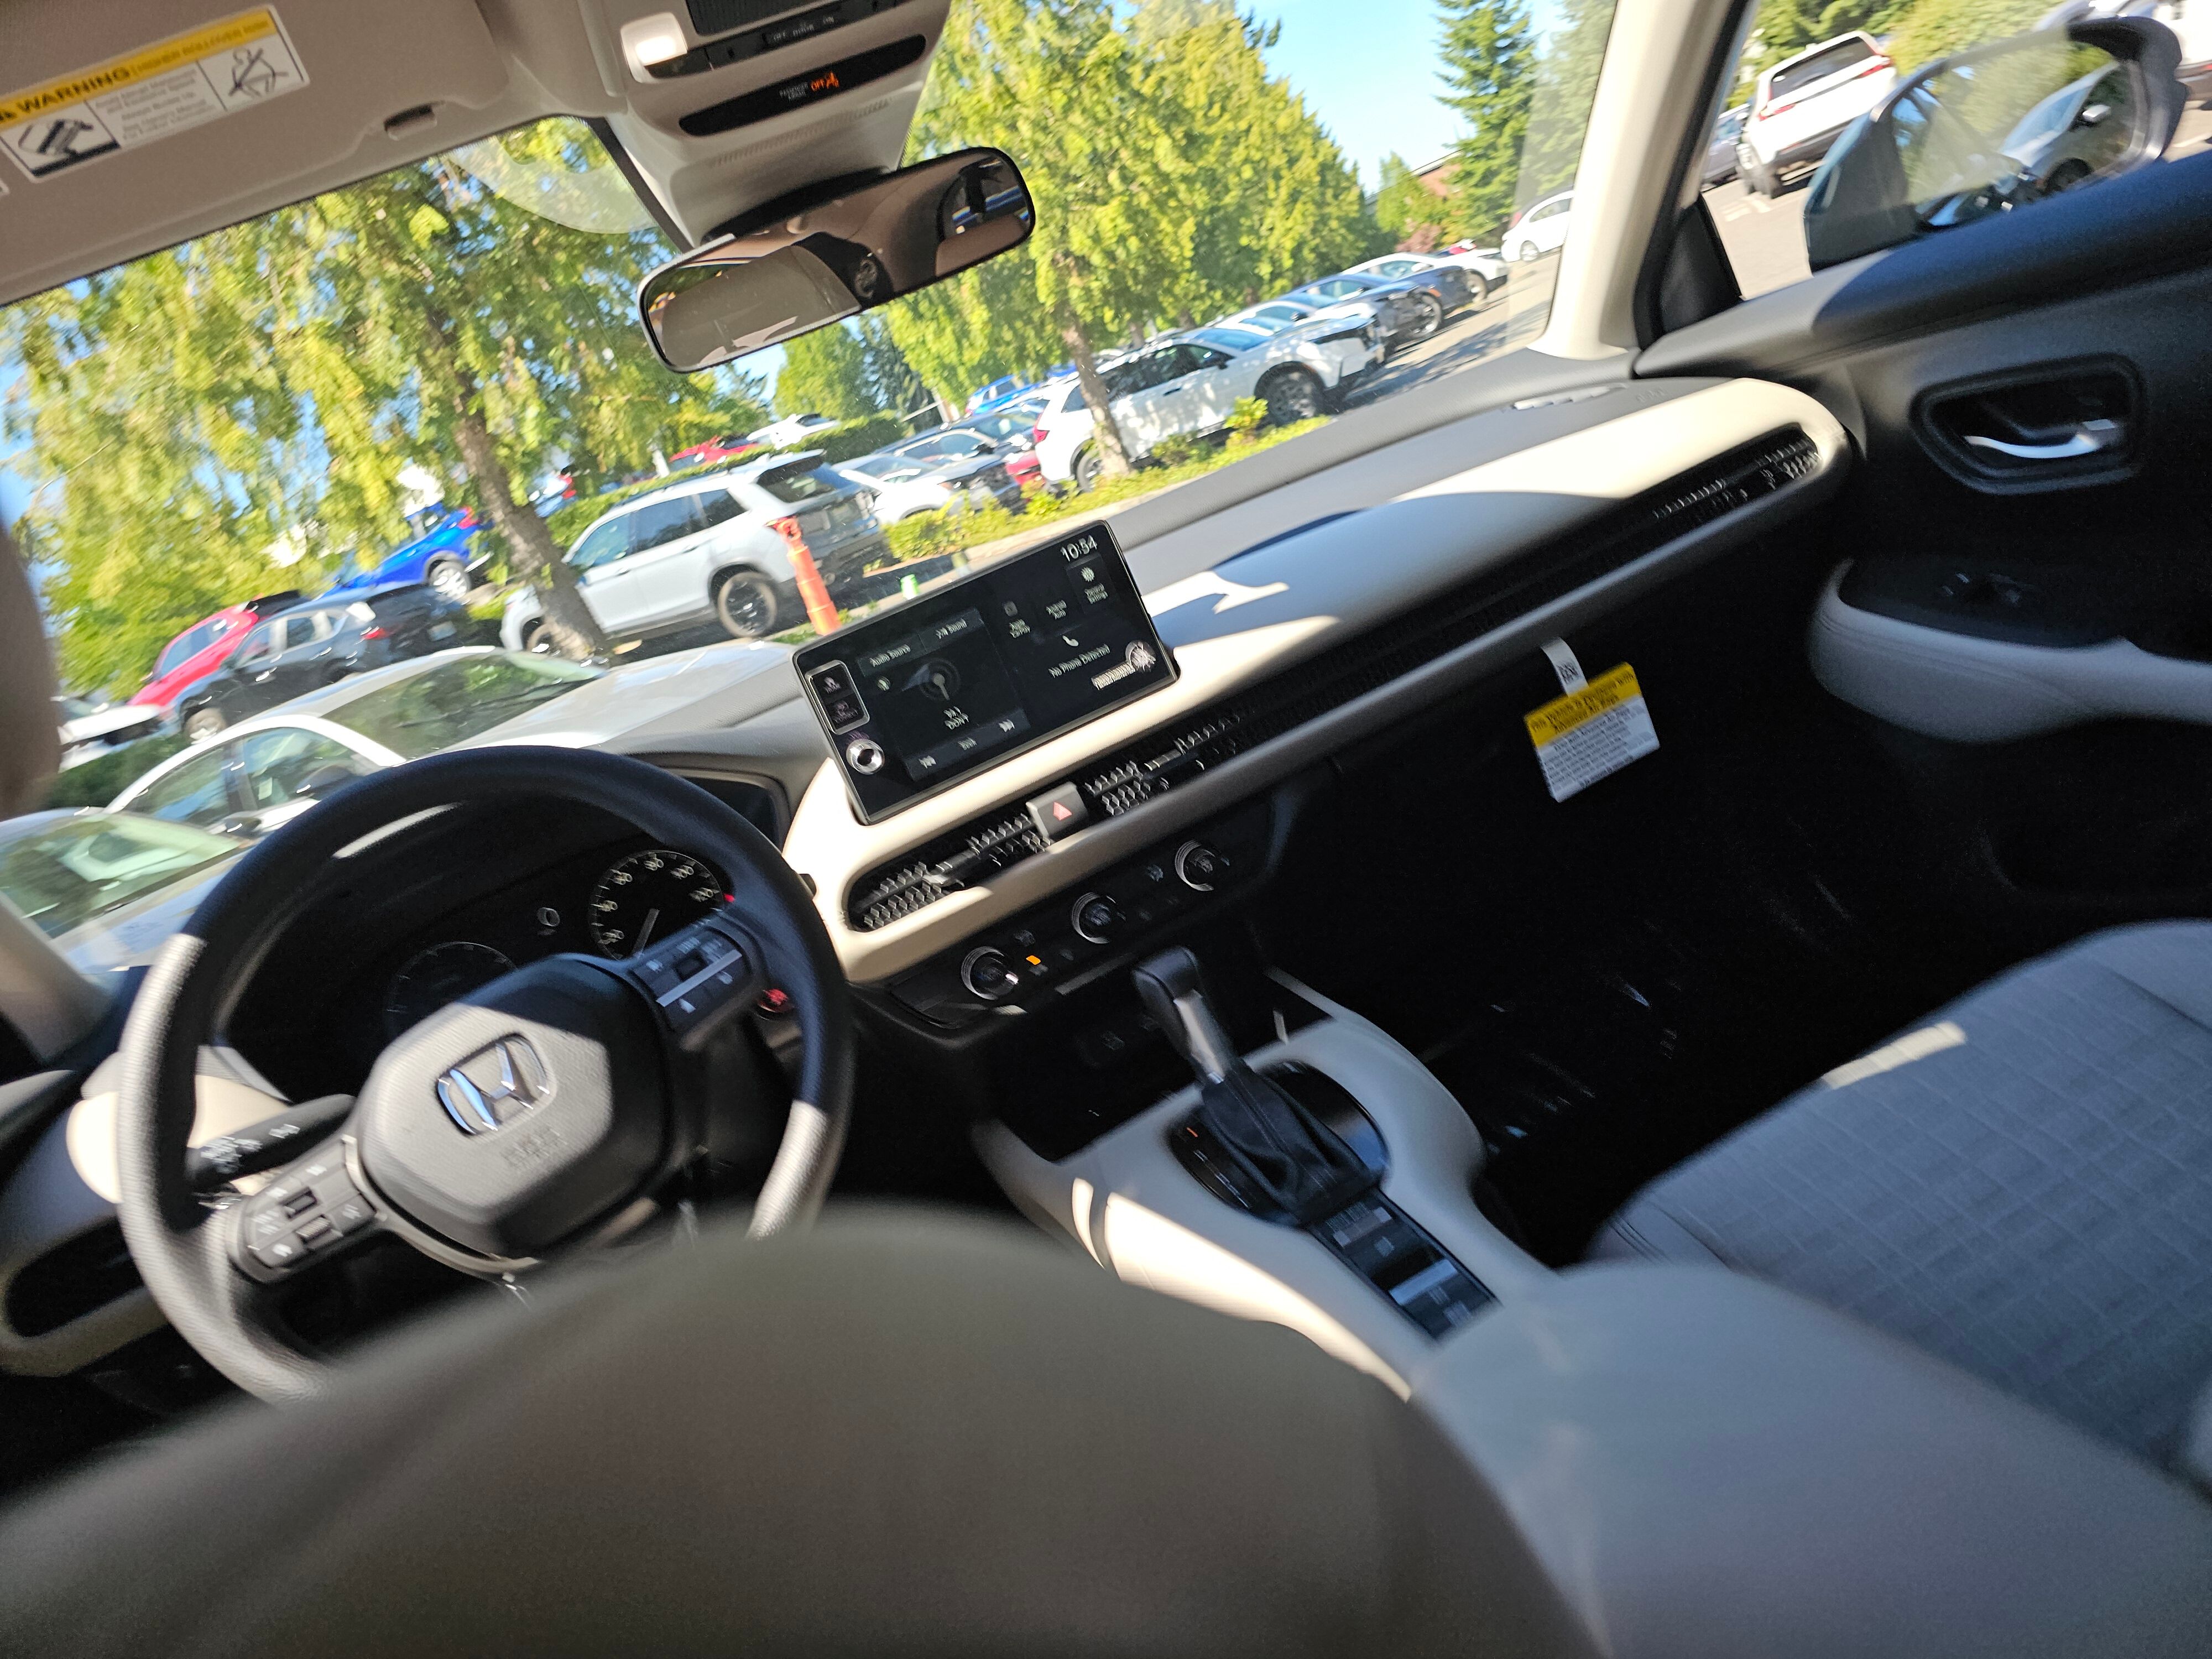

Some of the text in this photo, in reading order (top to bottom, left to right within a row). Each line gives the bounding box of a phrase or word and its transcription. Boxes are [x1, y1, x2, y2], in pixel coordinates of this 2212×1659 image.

[15, 66, 131, 114] WARNING
[811, 79, 825, 92] OFF
[1061, 535, 1097, 561] 10:54
[870, 645, 910, 667] Audio Source
[1048, 644, 1110, 677] No Phone Detected
